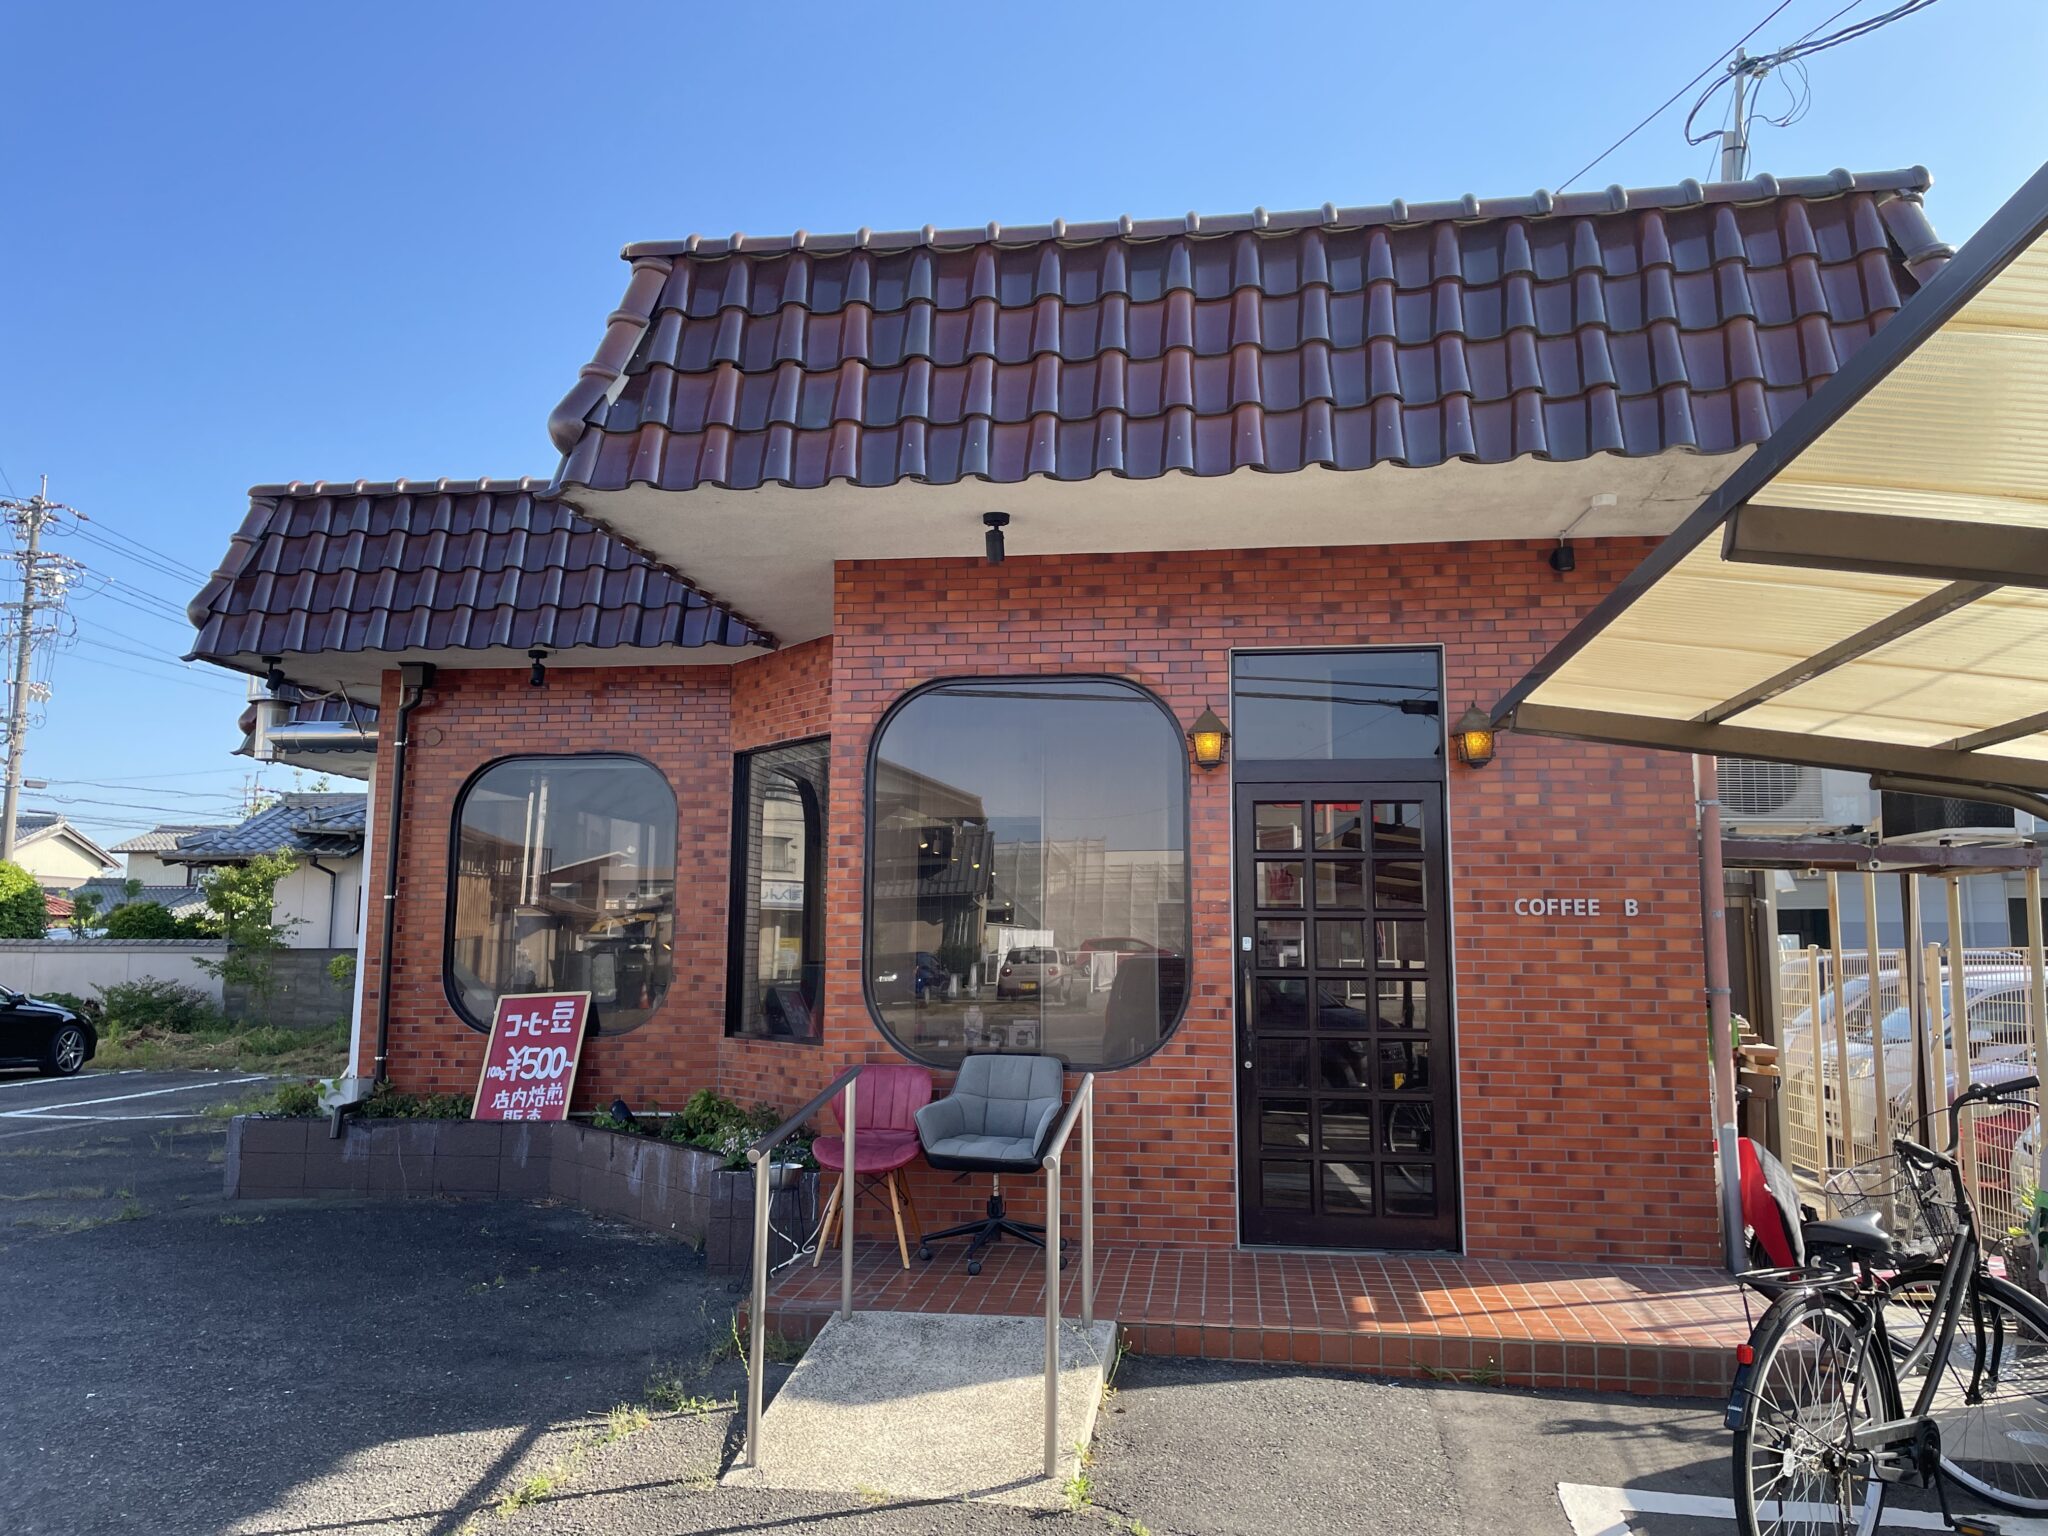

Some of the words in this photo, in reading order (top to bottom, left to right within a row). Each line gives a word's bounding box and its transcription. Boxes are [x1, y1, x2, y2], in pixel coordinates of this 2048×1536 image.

[1514, 898, 1600, 916] COFFEE
[1624, 898, 1639, 916] B
[490, 1082, 564, 1109] 店内焙煎
